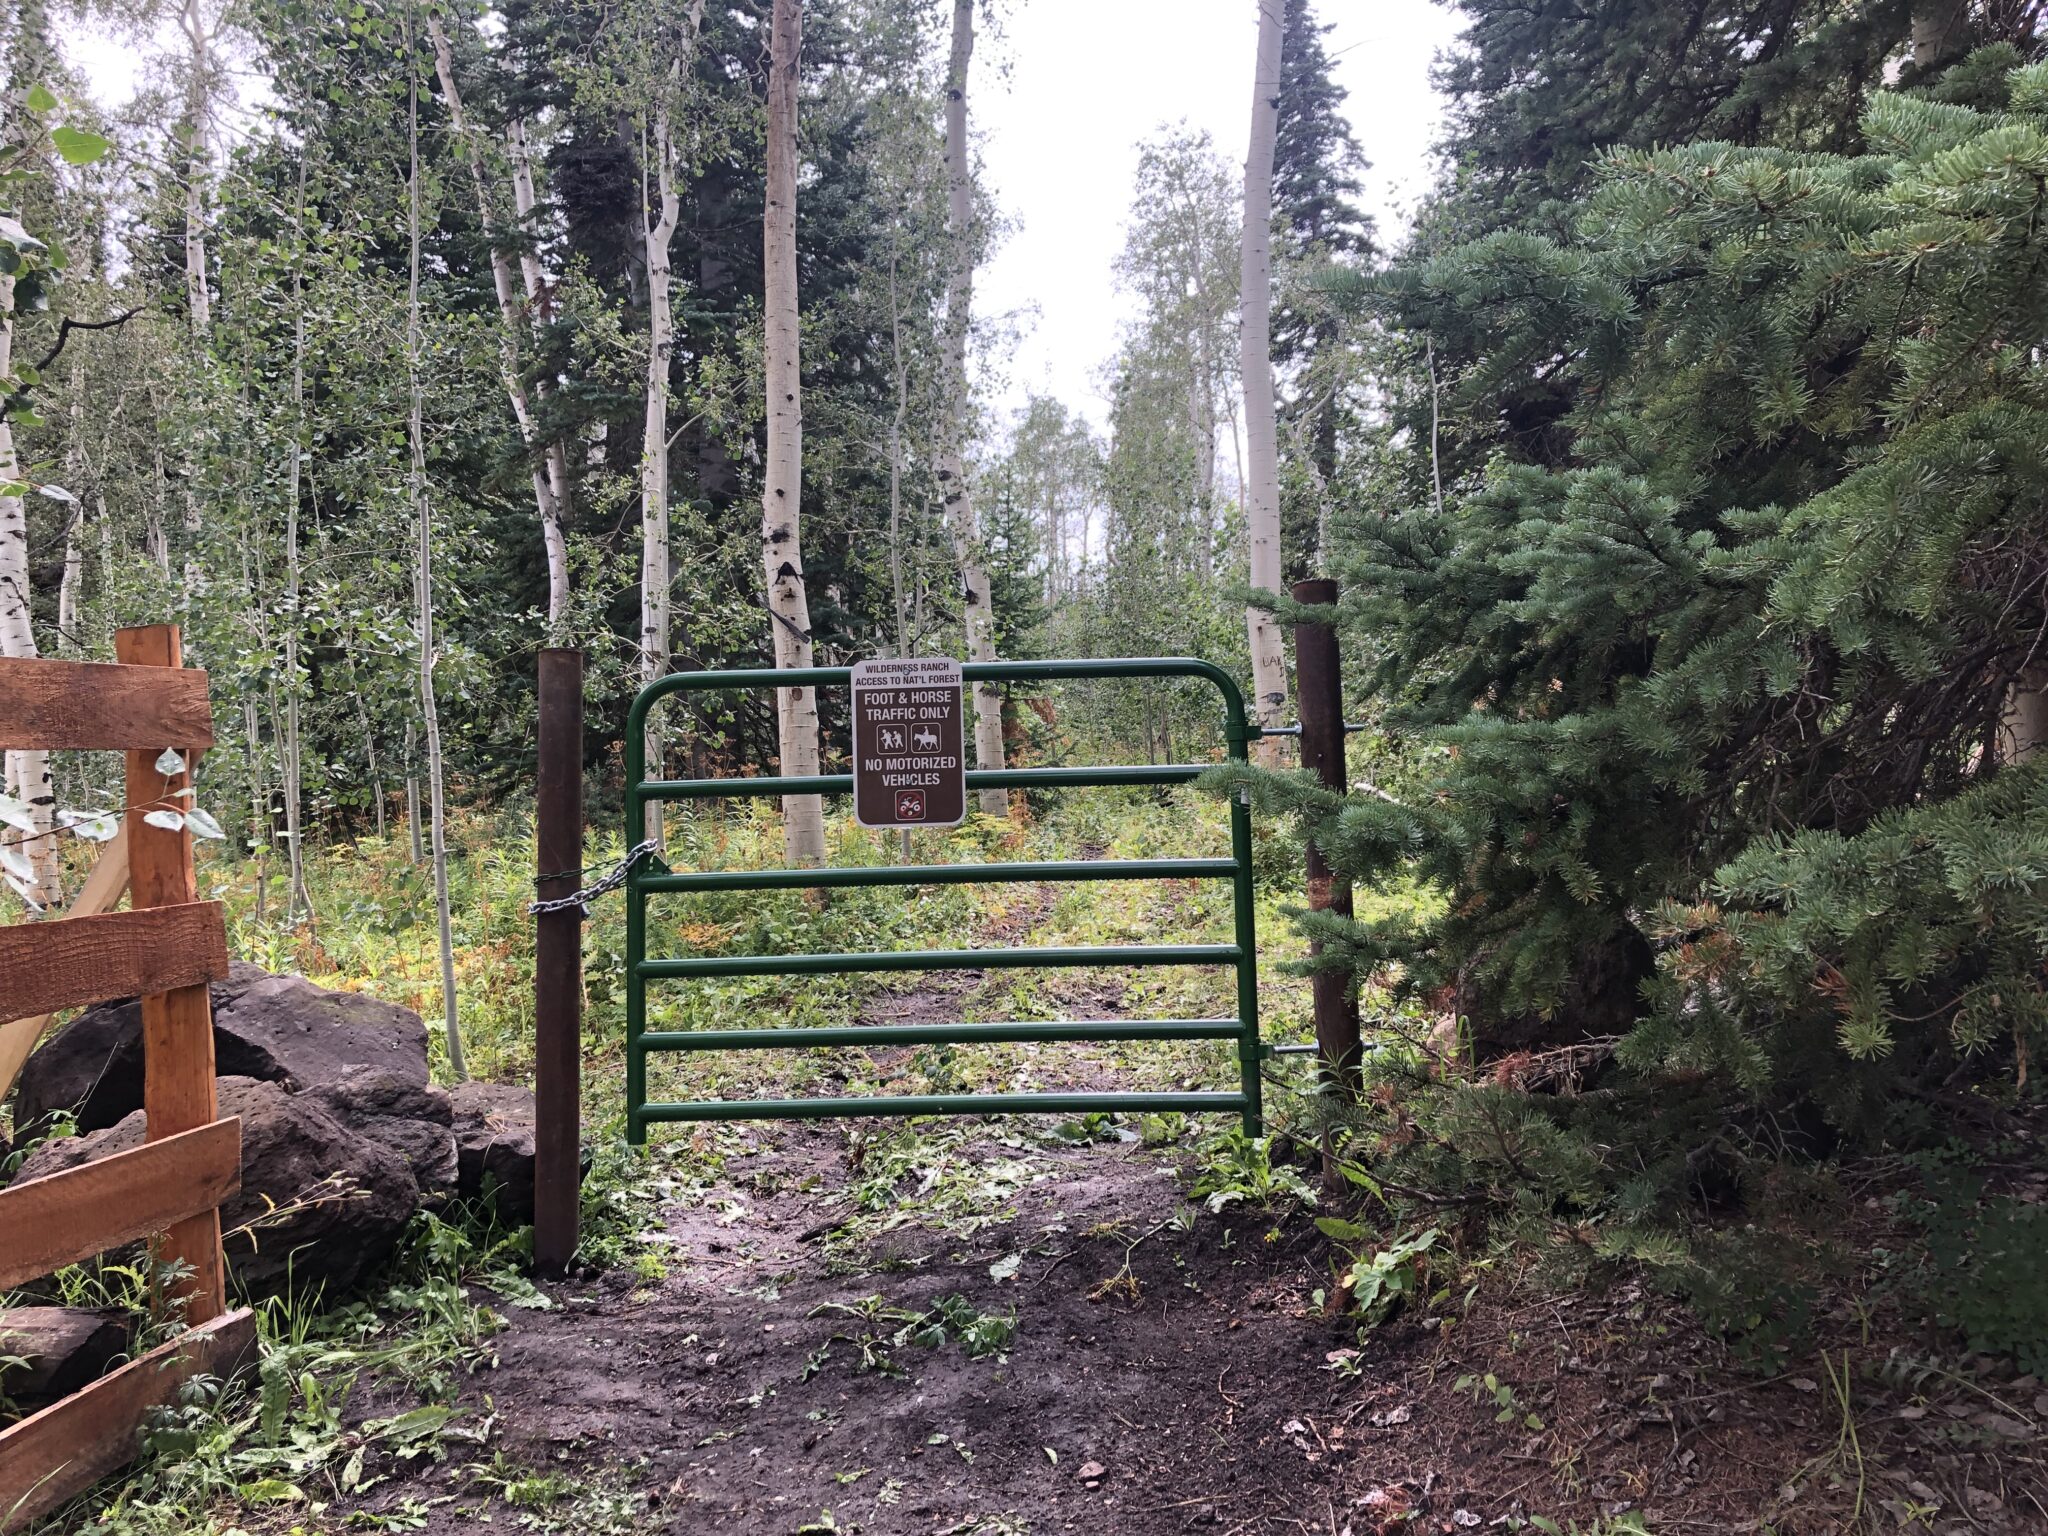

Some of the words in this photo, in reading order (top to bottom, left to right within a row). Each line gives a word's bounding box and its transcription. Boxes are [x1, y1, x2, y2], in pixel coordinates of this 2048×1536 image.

[865, 664, 918, 674] WILDERNESS
[920, 662, 950, 671] RANCH
[855, 677, 888, 686] ACCESS
[890, 676, 901, 685] TO
[903, 675, 927, 684] NAT'L
[928, 674, 960, 683] FOREST
[864, 692, 894, 705] FOOT
[898, 691, 908, 704] &
[911, 690, 951, 703] HORSE
[866, 708, 917, 721] TRAFFIC
[919, 706, 951, 719] ONLY
[865, 758, 883, 771] NO
[886, 756, 956, 770] MOTORIZED
[882, 773, 940, 786] VEHICLES
